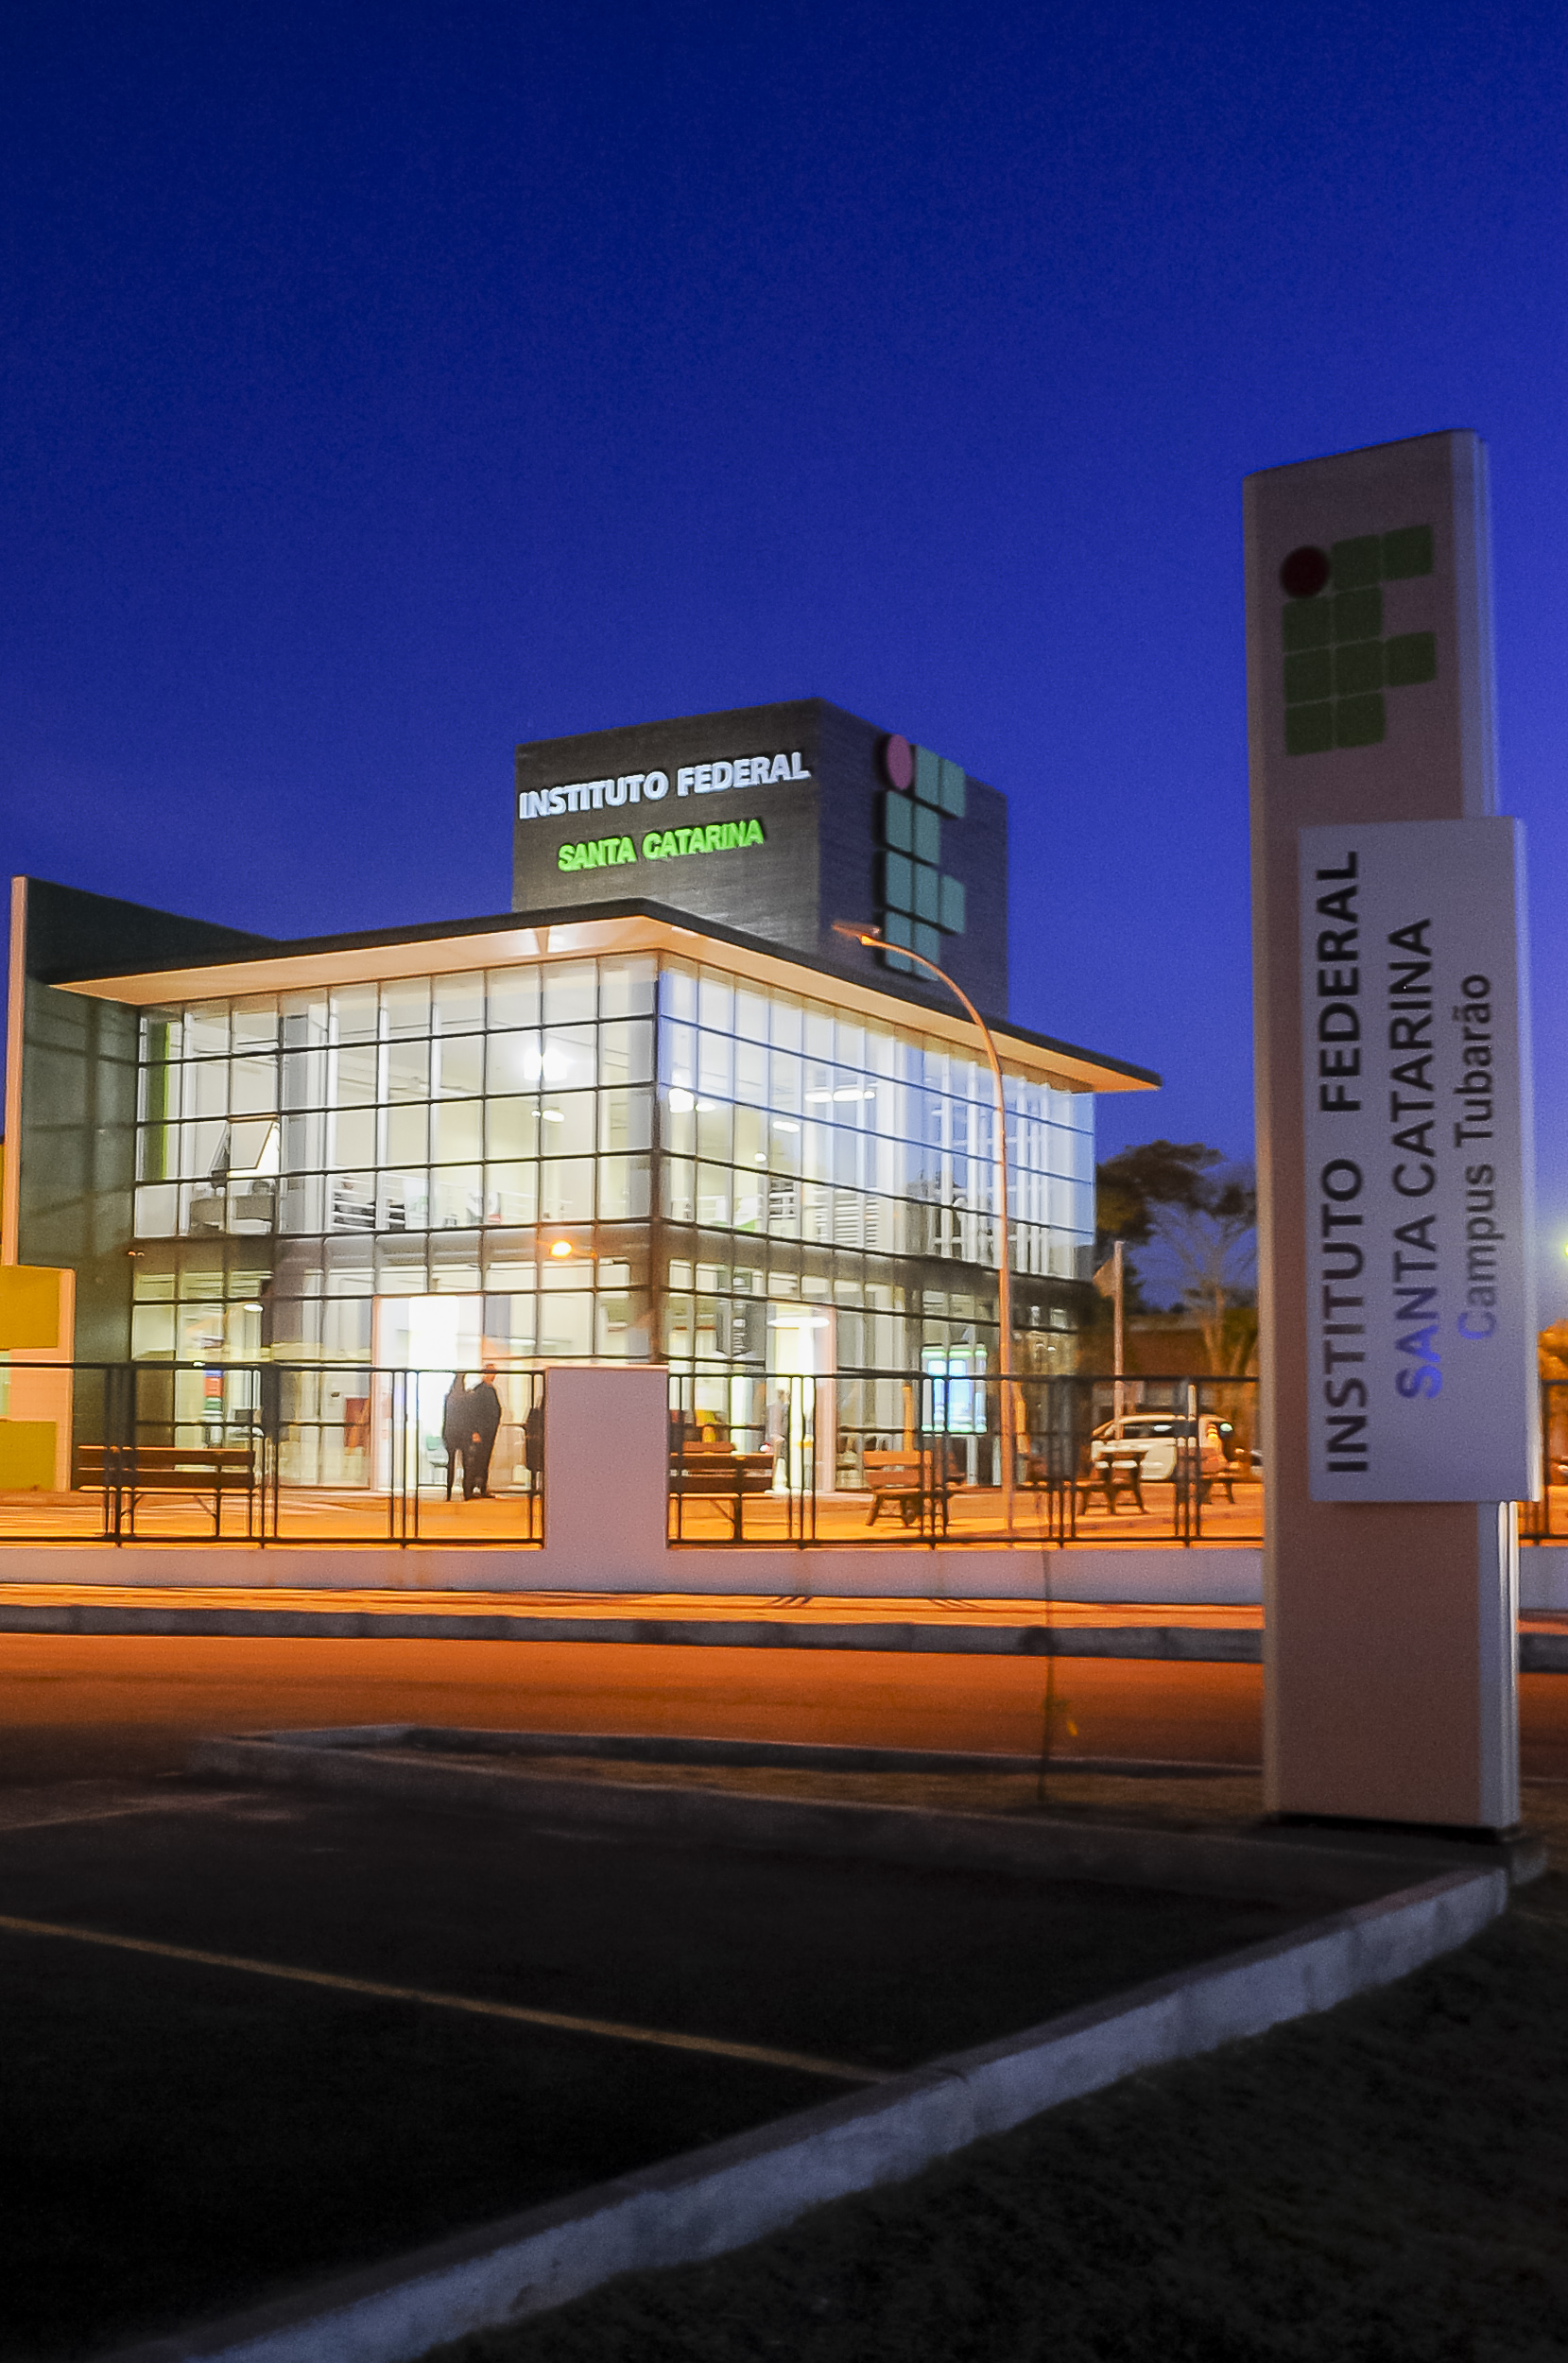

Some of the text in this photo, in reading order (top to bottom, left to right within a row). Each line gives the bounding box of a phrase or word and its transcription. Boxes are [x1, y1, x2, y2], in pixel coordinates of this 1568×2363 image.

[519, 751, 811, 819] INSTITUTO FEDERAL
[558, 819, 764, 871] SANTA CATARINA
[1316, 852, 1369, 1473] INSTITUTO FEDERAL
[1387, 918, 1443, 1399] SANTA CATARINA
[1452, 975, 1506, 1340] Campus Tubarão
